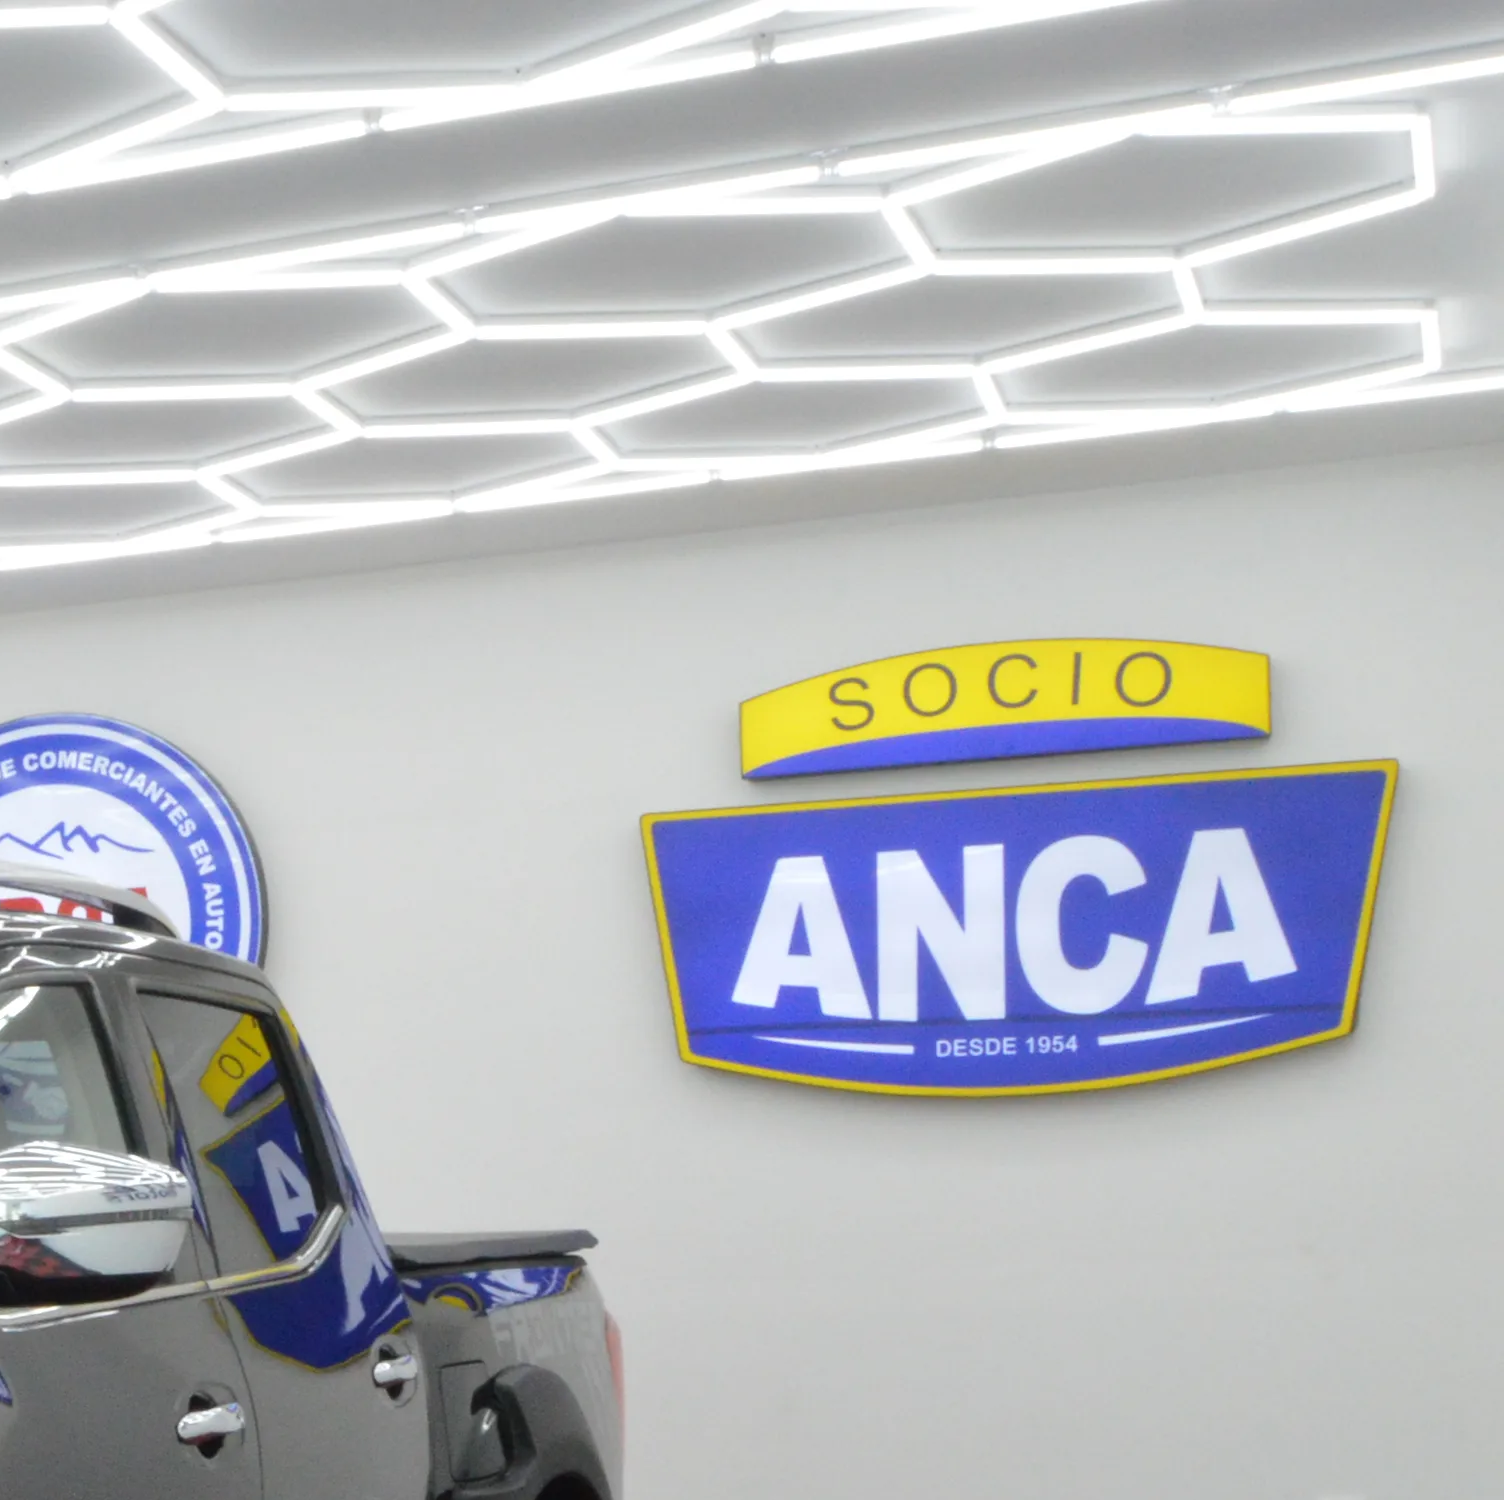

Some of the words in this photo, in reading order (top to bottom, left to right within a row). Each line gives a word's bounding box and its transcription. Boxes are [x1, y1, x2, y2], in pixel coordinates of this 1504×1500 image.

[828, 651, 1172, 731] SOCIO
[22, 750, 197, 838] COMERCIANTES
[188, 838, 217, 877] EN
[731, 827, 1298, 1022] ANCA
[935, 1037, 1017, 1058] DESDE
[1025, 1034, 1079, 1054] 1954
